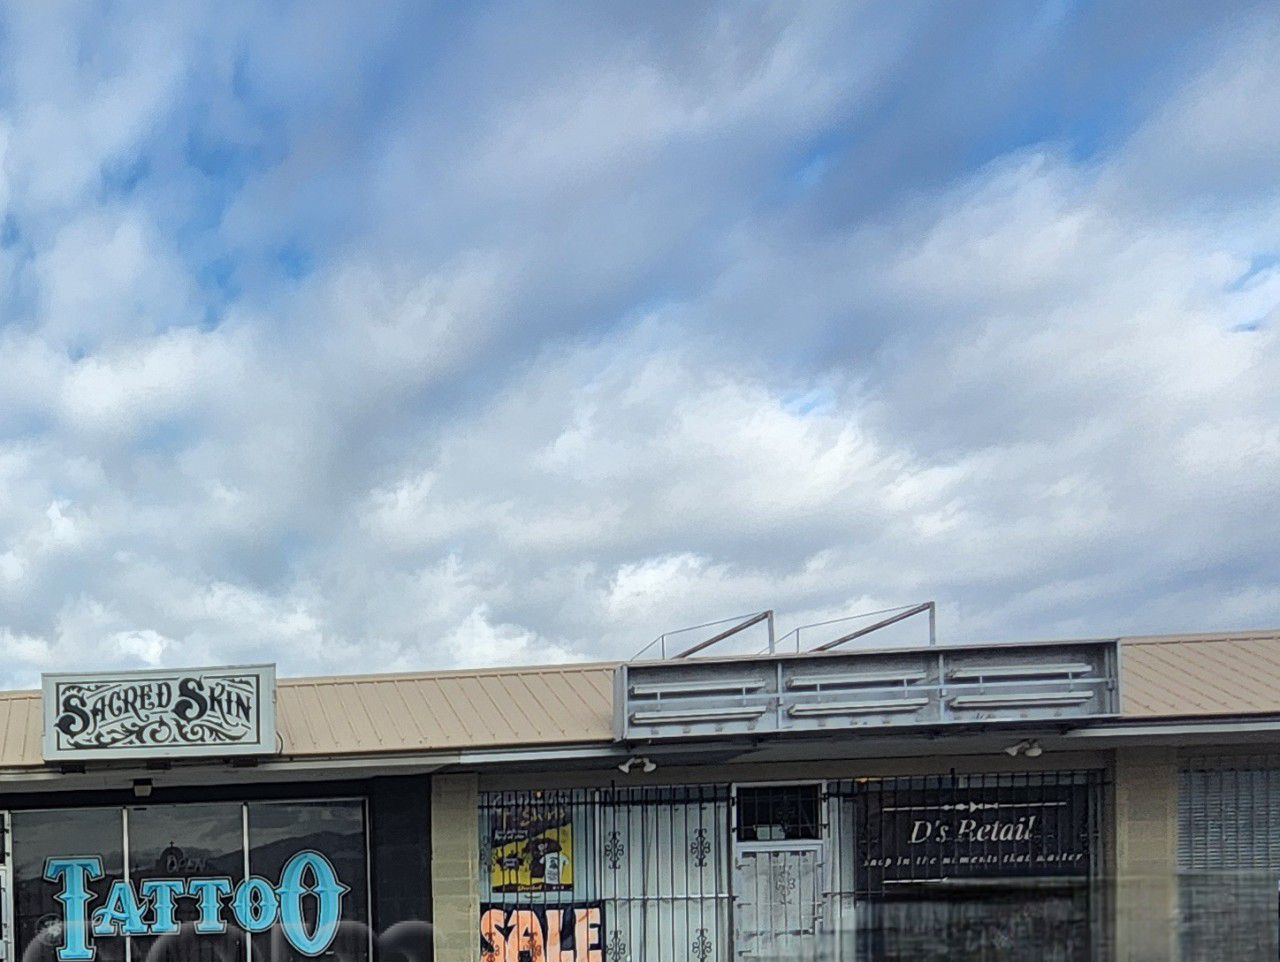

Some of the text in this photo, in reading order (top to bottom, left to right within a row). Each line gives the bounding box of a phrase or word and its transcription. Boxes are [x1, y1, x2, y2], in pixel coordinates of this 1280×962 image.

[54, 675, 252, 738] SACRED SKIN
[907, 816, 1036, 844] D's Retail
[43, 849, 351, 962] TATTOO
